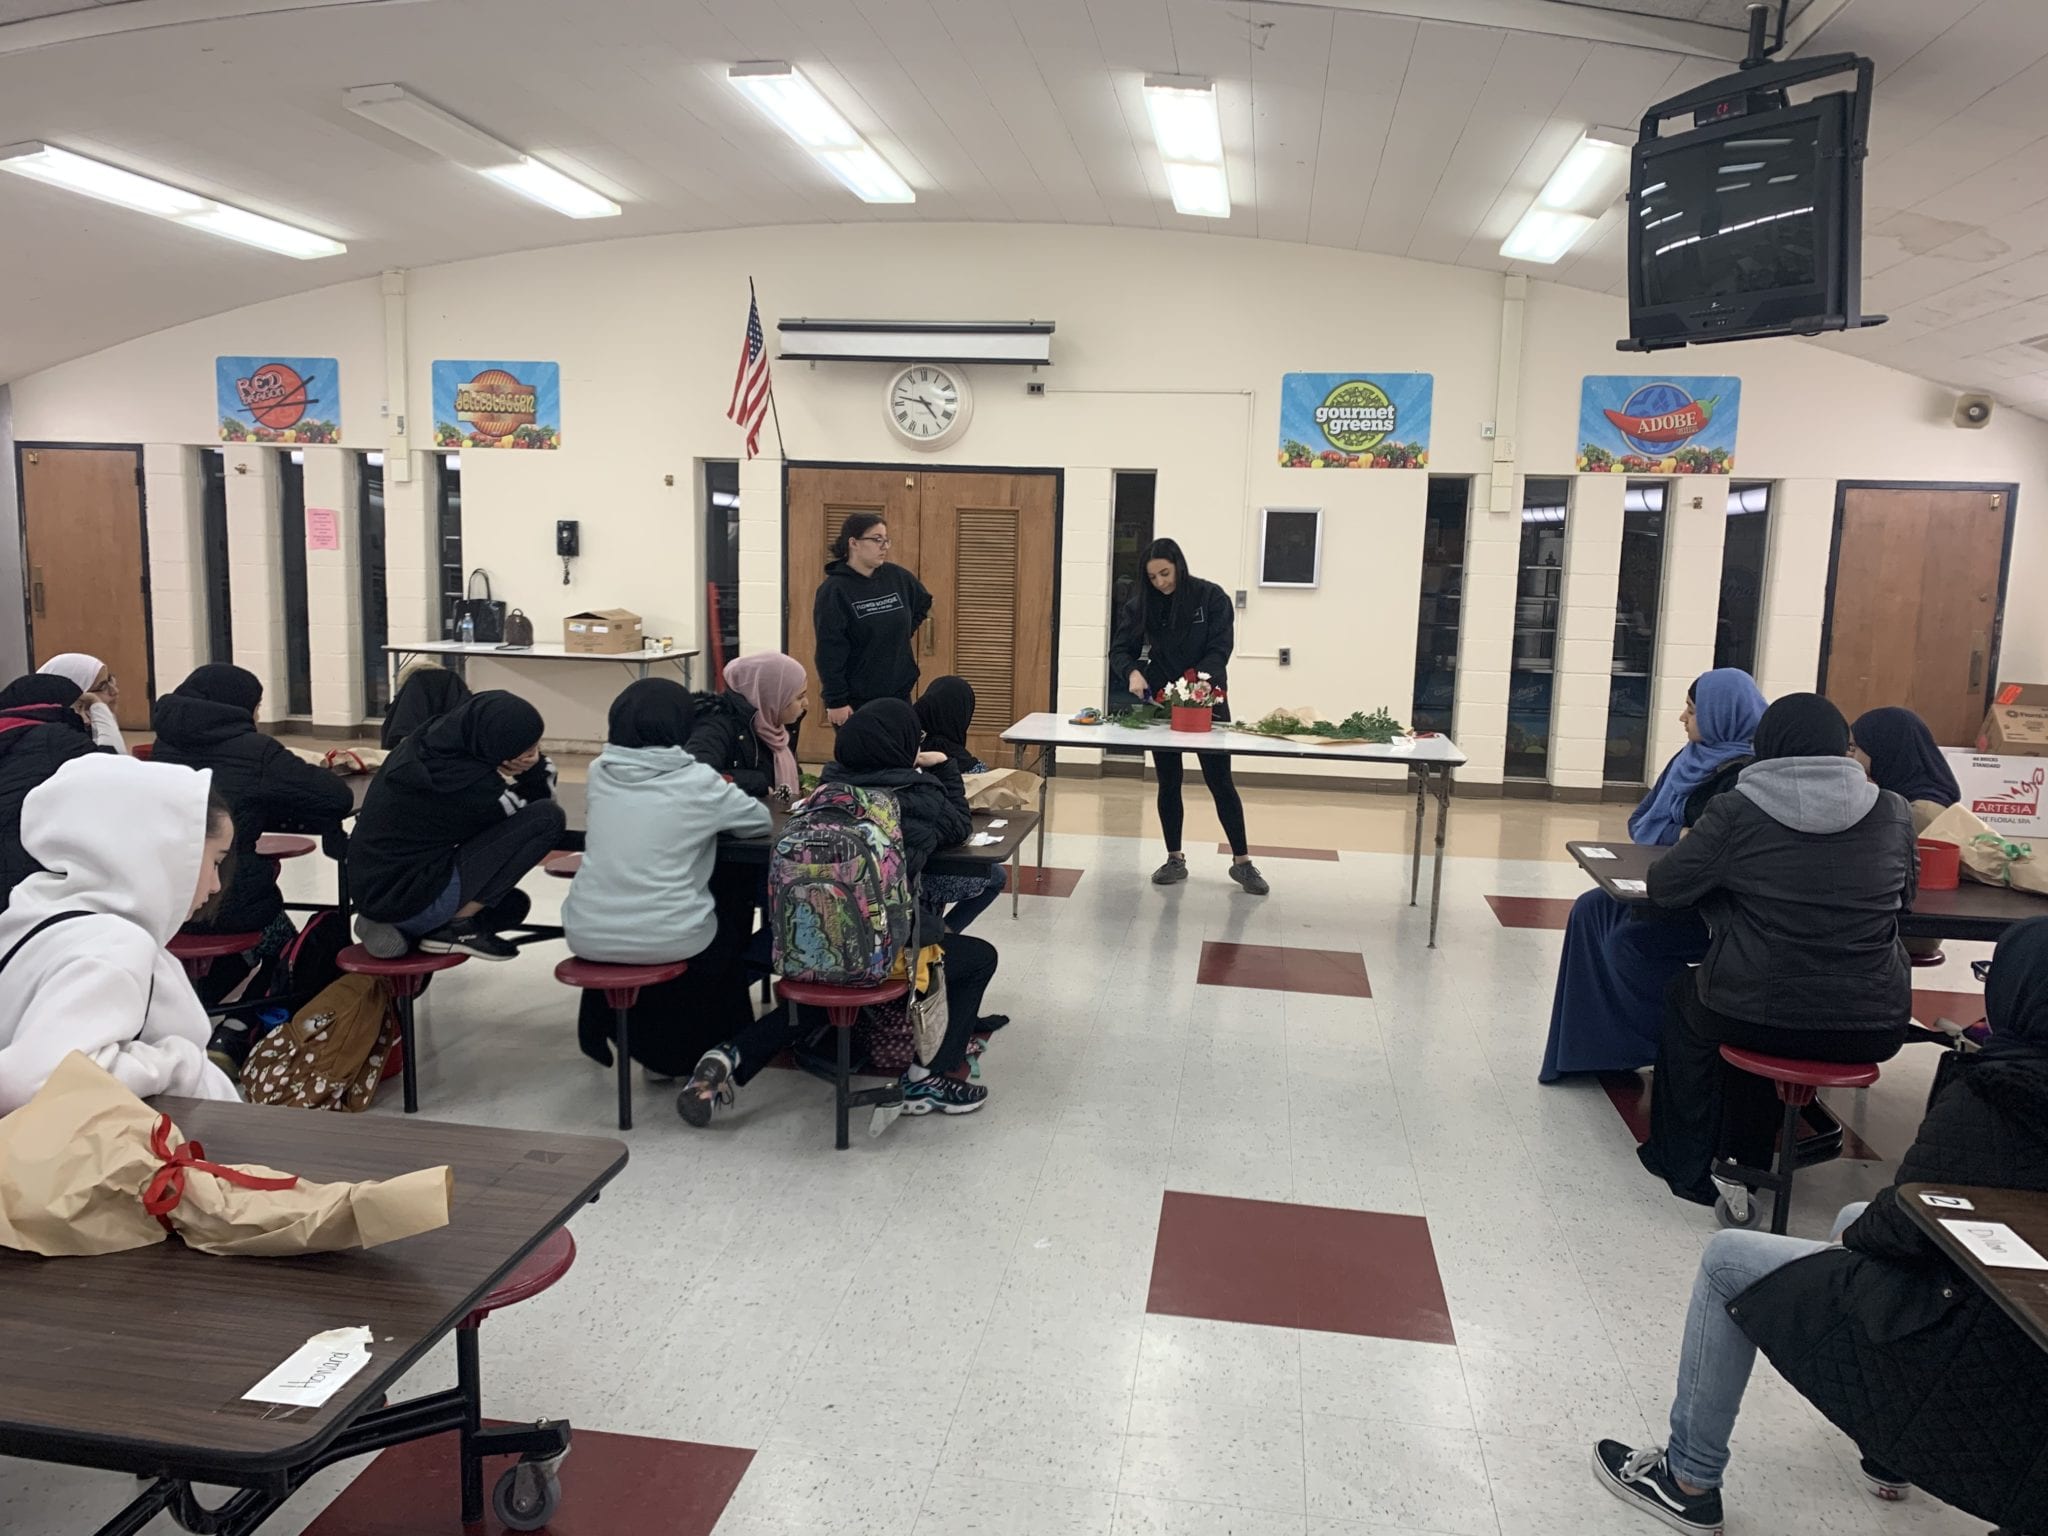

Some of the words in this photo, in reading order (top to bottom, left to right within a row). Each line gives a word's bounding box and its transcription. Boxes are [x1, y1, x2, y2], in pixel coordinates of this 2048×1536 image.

[237, 371, 282, 398] RED
[1315, 405, 1395, 422] gourmet
[1637, 411, 1698, 434] ADOBE
[1329, 419, 1394, 435] greens
[1975, 802, 2033, 815] ARTESIA
[278, 1351, 350, 1388] Howard
